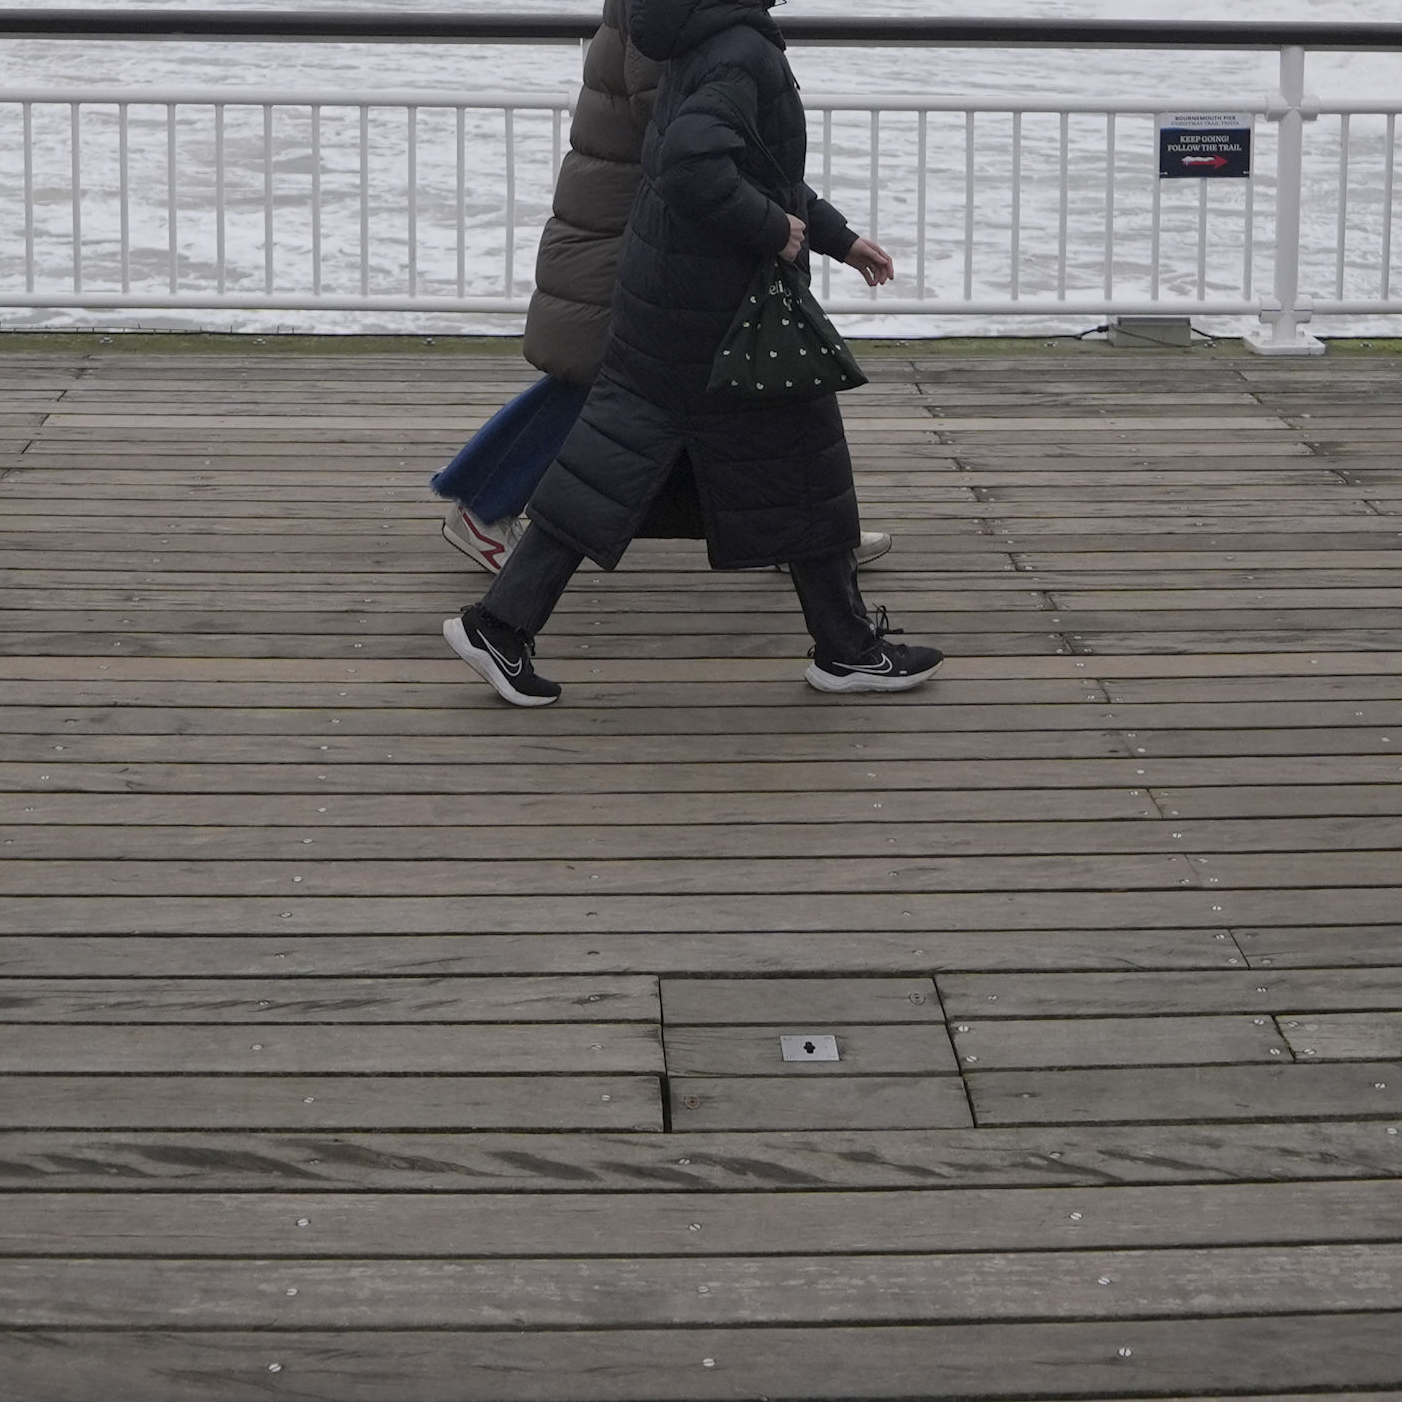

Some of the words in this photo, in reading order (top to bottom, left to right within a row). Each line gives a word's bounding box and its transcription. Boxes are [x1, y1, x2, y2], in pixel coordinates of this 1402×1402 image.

[1180, 135, 1201, 143] KEEP
[1201, 135, 1230, 143] GOING!
[1167, 144, 1201, 152] FOLLOW
[1201, 144, 1218, 152] THE
[1218, 143, 1242, 152] TRAIL
